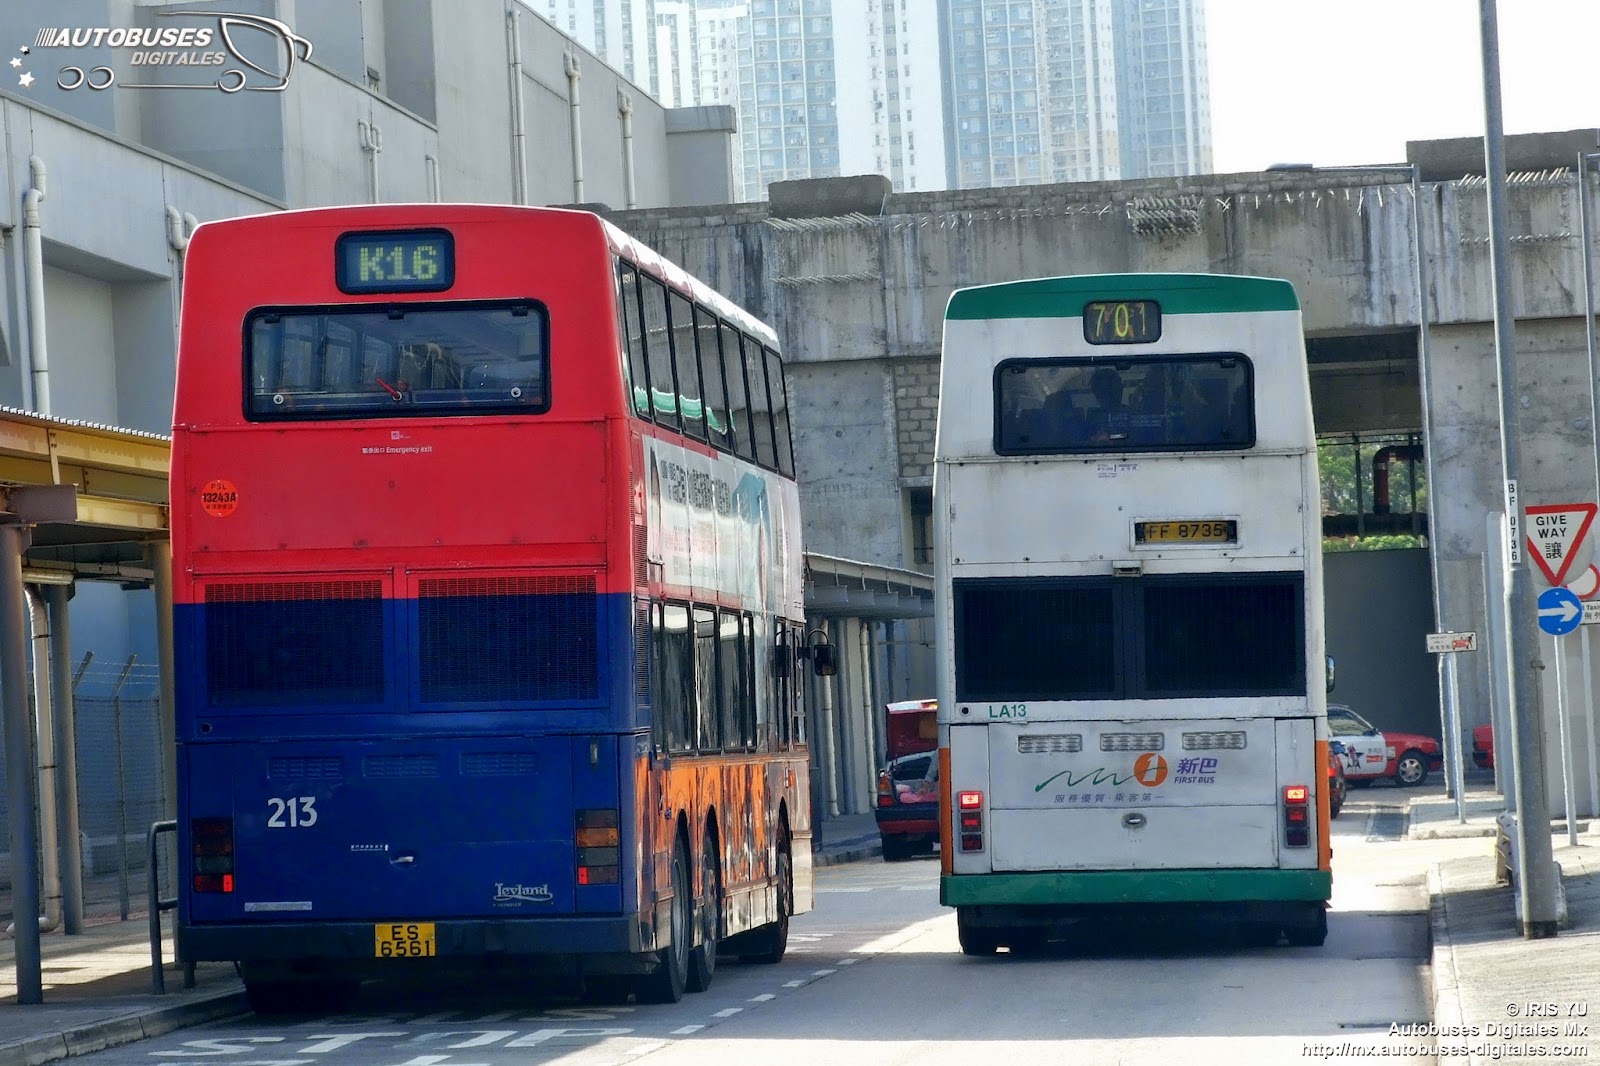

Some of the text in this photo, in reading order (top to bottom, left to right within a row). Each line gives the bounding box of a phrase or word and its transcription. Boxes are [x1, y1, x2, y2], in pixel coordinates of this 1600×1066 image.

[359, 245, 438, 282] K16
[1092, 303, 1148, 338] 701
[386, 446, 420, 454] Emergency
[202, 491, 237, 503] 13243A
[1536, 515, 1567, 526] GIVE
[1148, 523, 1224, 539] FF 8735
[1538, 528, 1567, 539] WAY
[1545, 542, 1563, 559] 讓
[989, 704, 1027, 719] LA13
[1176, 757, 1218, 774] 新巴
[1174, 776, 1216, 784] FIRST BUS
[267, 796, 318, 828] 213
[493, 883, 550, 899] Leyland
[391, 924, 420, 940] ES
[380, 940, 431, 956] 6561
